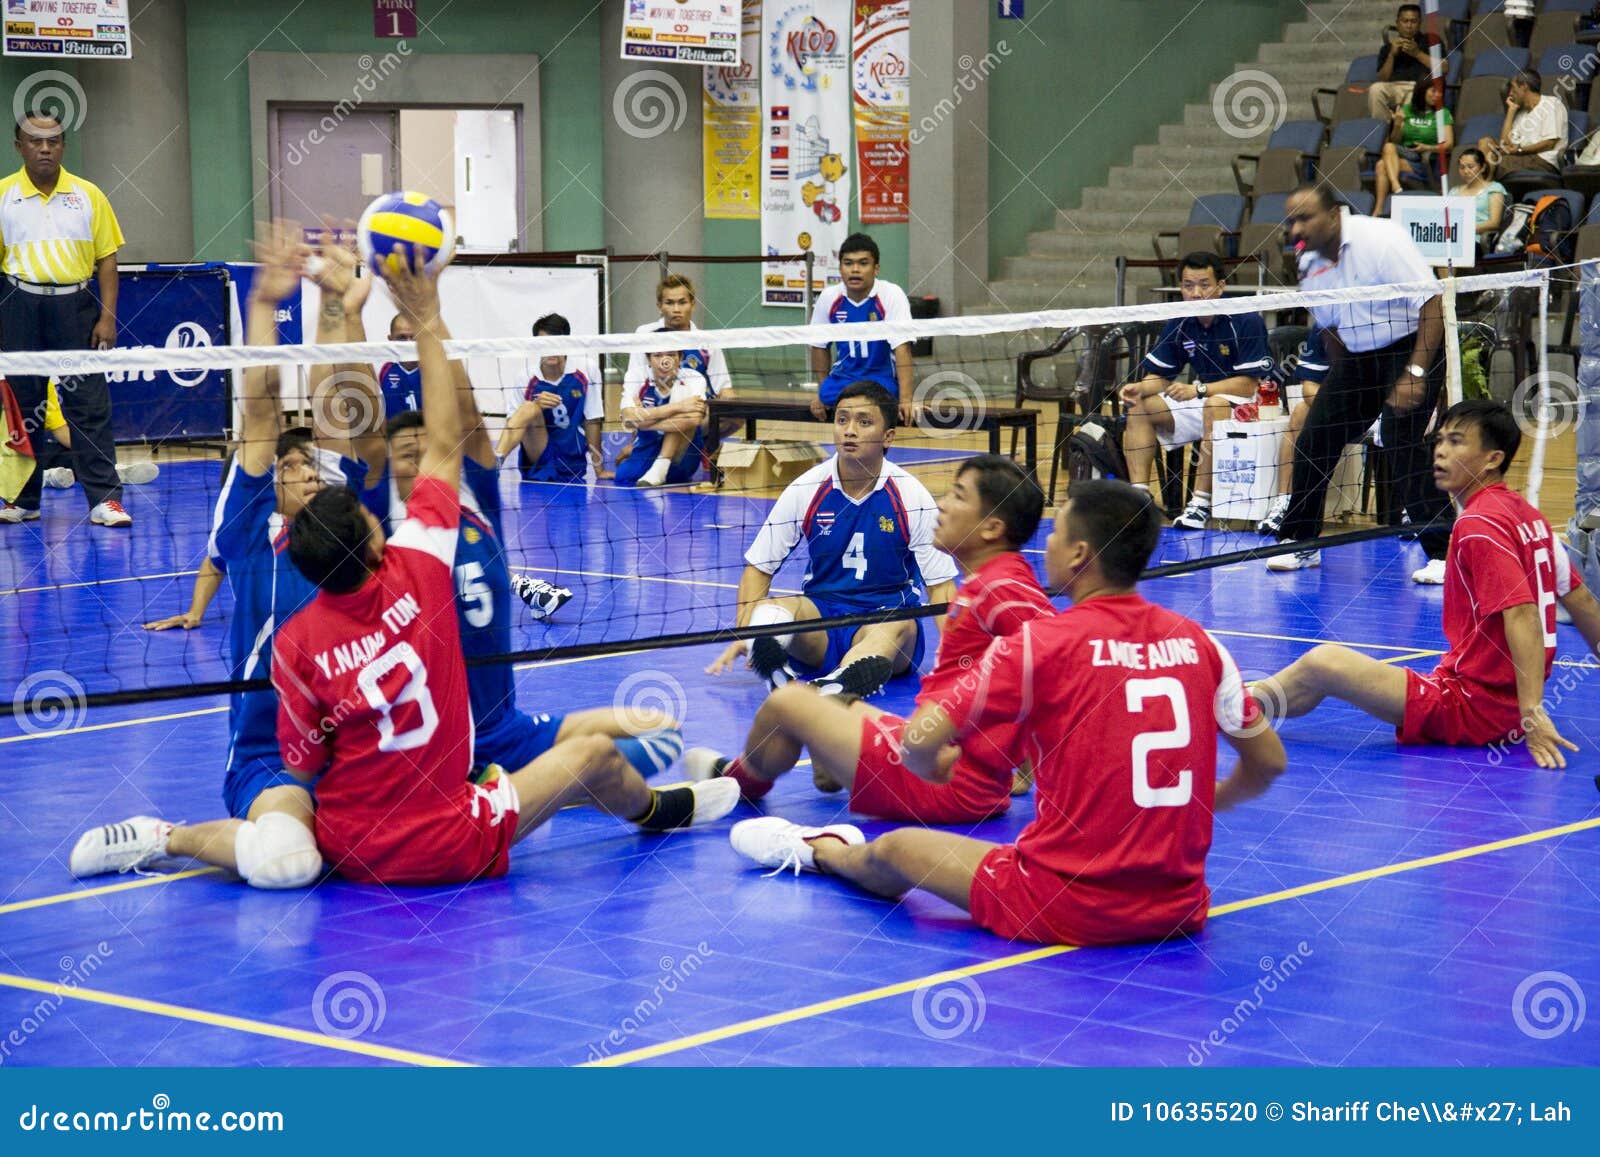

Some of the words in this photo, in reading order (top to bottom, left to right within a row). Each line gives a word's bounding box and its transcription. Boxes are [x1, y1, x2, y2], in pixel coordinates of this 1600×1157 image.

[30, 2, 58, 13] MOVING
[62, 2, 97, 14] TOGETHER
[387, 12, 404, 36] 1
[66, 41, 112, 55] Pelikan
[679, 48, 722, 62] Pelikan
[868, 60, 905, 79] KL09
[552, 402, 569, 430] 8
[842, 532, 868, 580] 4
[455, 561, 494, 628] 5
[382, 592, 422, 635] TUN
[1088, 638, 1147, 670] Z.MOE
[1147, 637, 1200, 670] AUNG
[1125, 676, 1193, 809] 2
